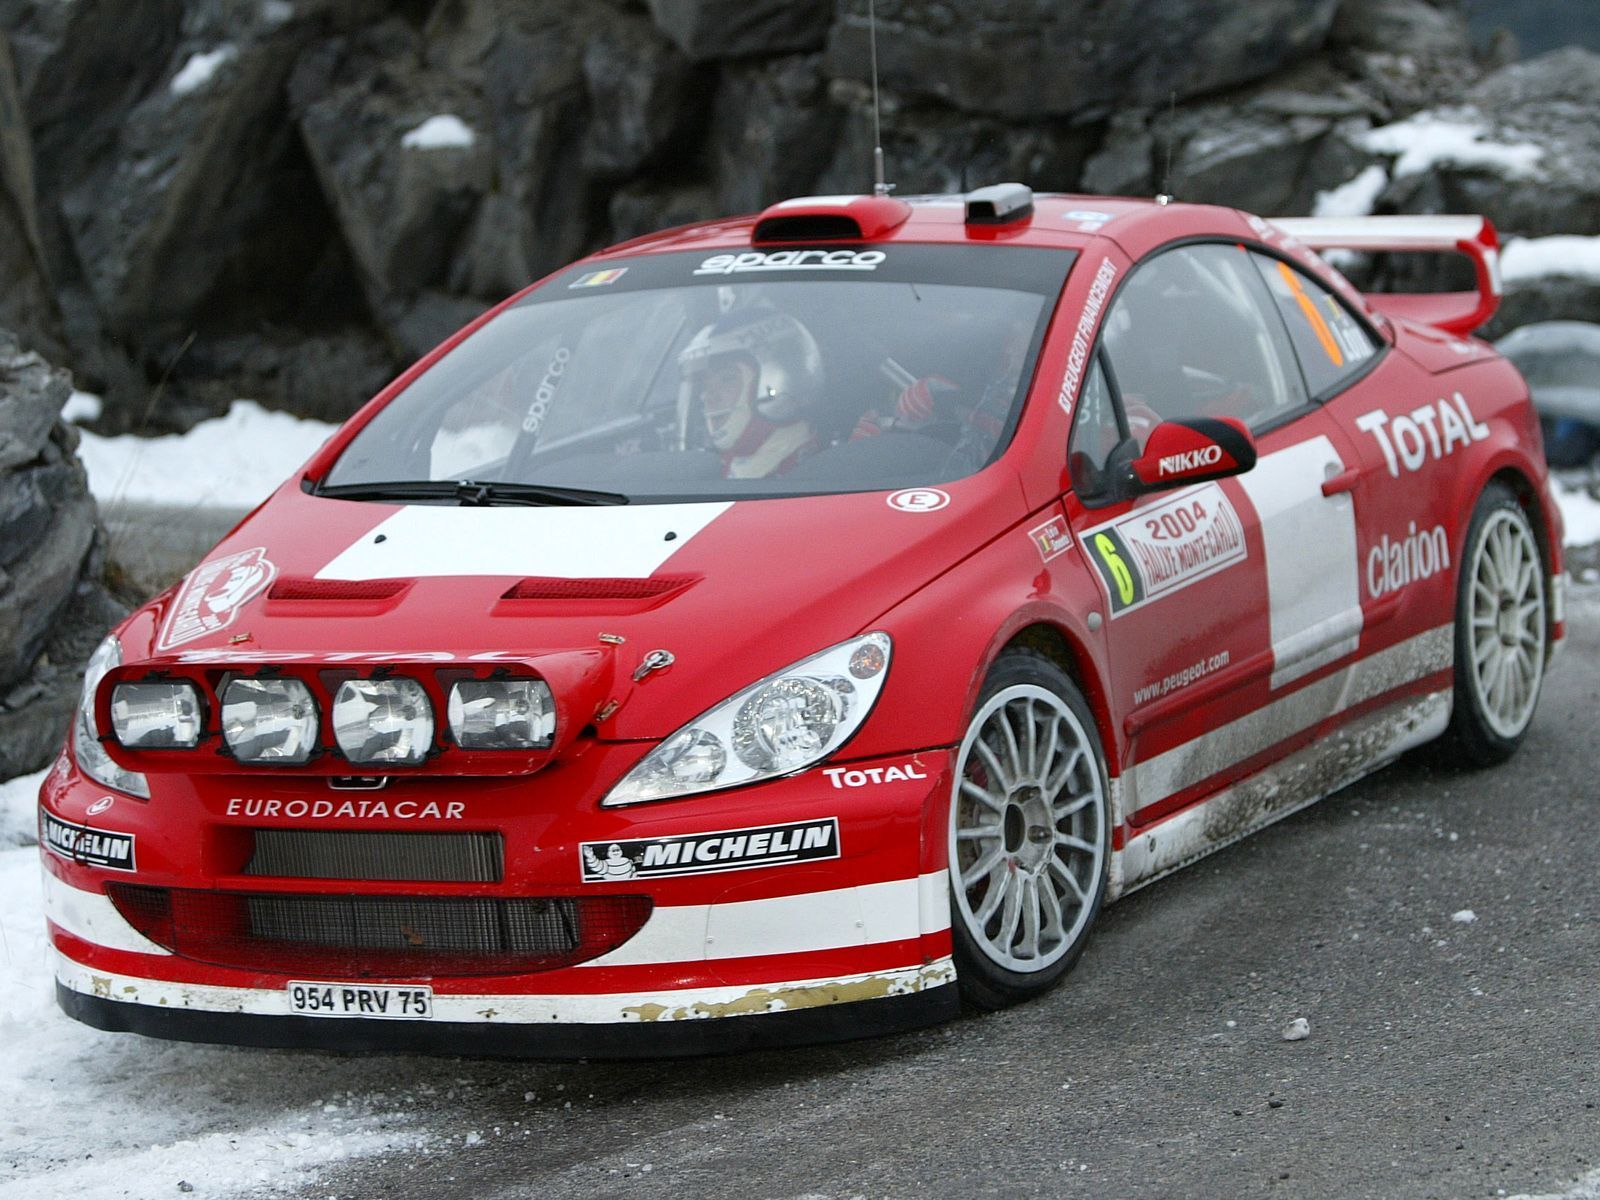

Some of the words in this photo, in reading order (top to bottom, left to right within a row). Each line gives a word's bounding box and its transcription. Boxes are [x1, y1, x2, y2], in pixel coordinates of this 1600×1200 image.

[694, 250, 886, 275] sparco
[1061, 331, 1089, 401] PEUGEOT
[1077, 256, 1118, 340] FINANCEMENT
[522, 347, 570, 432] sparco
[1355, 391, 1490, 478] TOTAL
[1159, 444, 1222, 476] NIKKO
[1145, 501, 1208, 540] 2004
[1094, 533, 1134, 605] 6
[1367, 520, 1450, 598] clarion
[1134, 650, 1230, 704] www.peugeot.com
[822, 763, 927, 789] TOTAL
[226, 798, 466, 819] EURODATACAR
[642, 824, 832, 867] MICHELIN
[293, 987, 335, 1011] 954
[342, 989, 389, 1013] PRV
[398, 991, 427, 1015] 75
